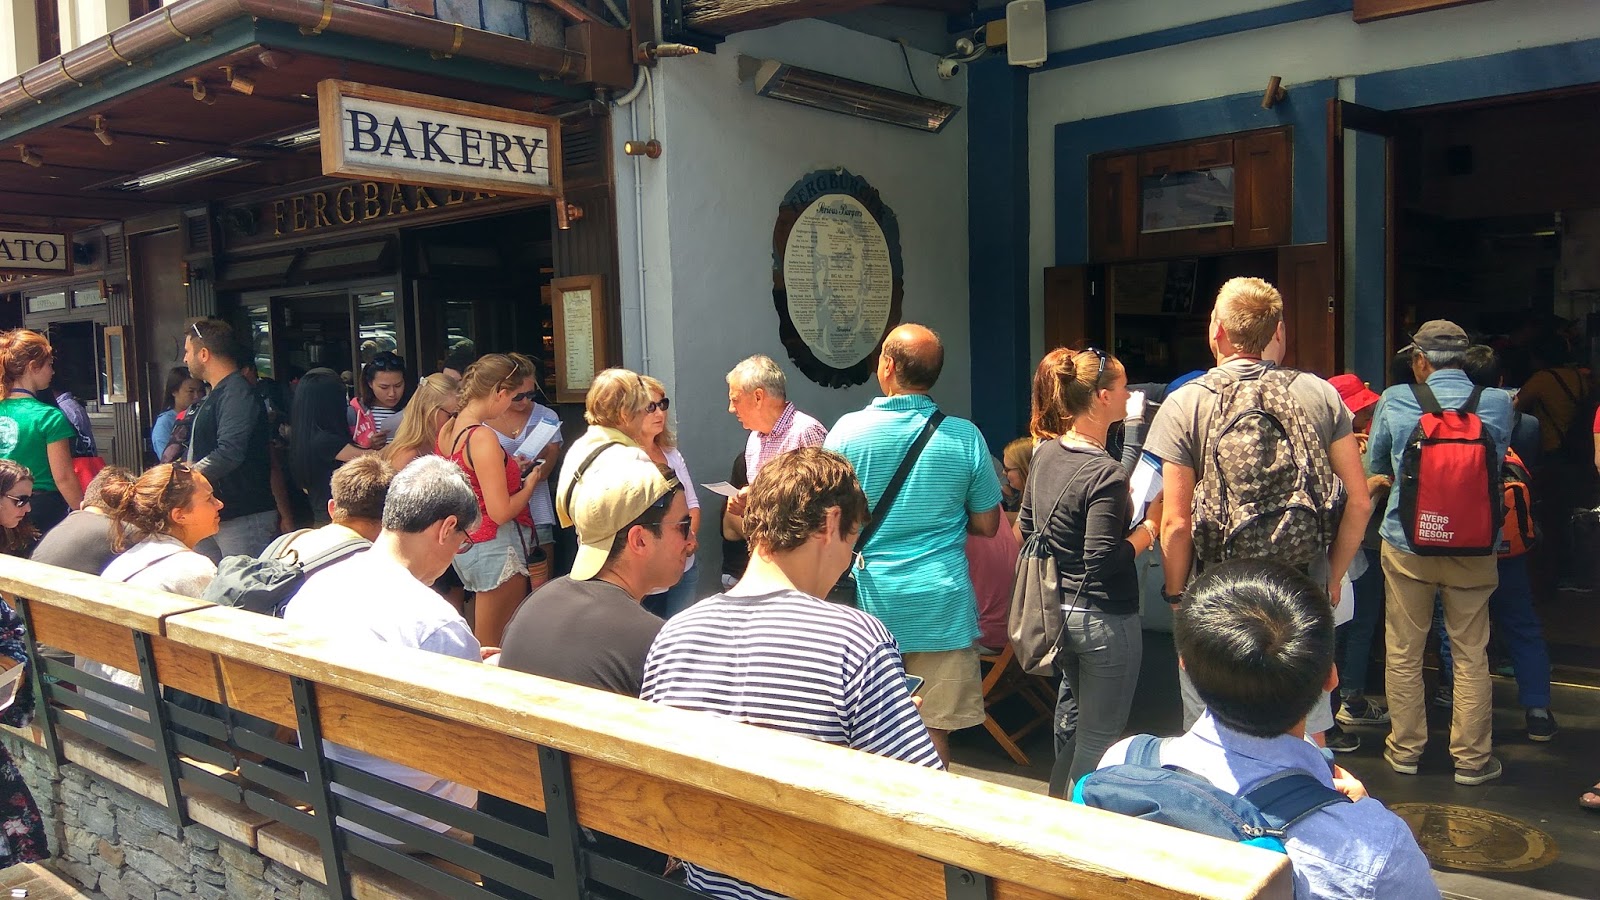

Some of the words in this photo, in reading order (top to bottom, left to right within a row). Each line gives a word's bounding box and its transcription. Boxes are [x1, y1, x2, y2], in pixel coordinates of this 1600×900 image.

[346, 109, 543, 174] BAKERY
[272, 181, 498, 237] FERGBAK
[1420, 514, 1449, 524] AYERS
[1420, 521, 1445, 531] ROCK
[1419, 528, 1454, 539] RESORT
